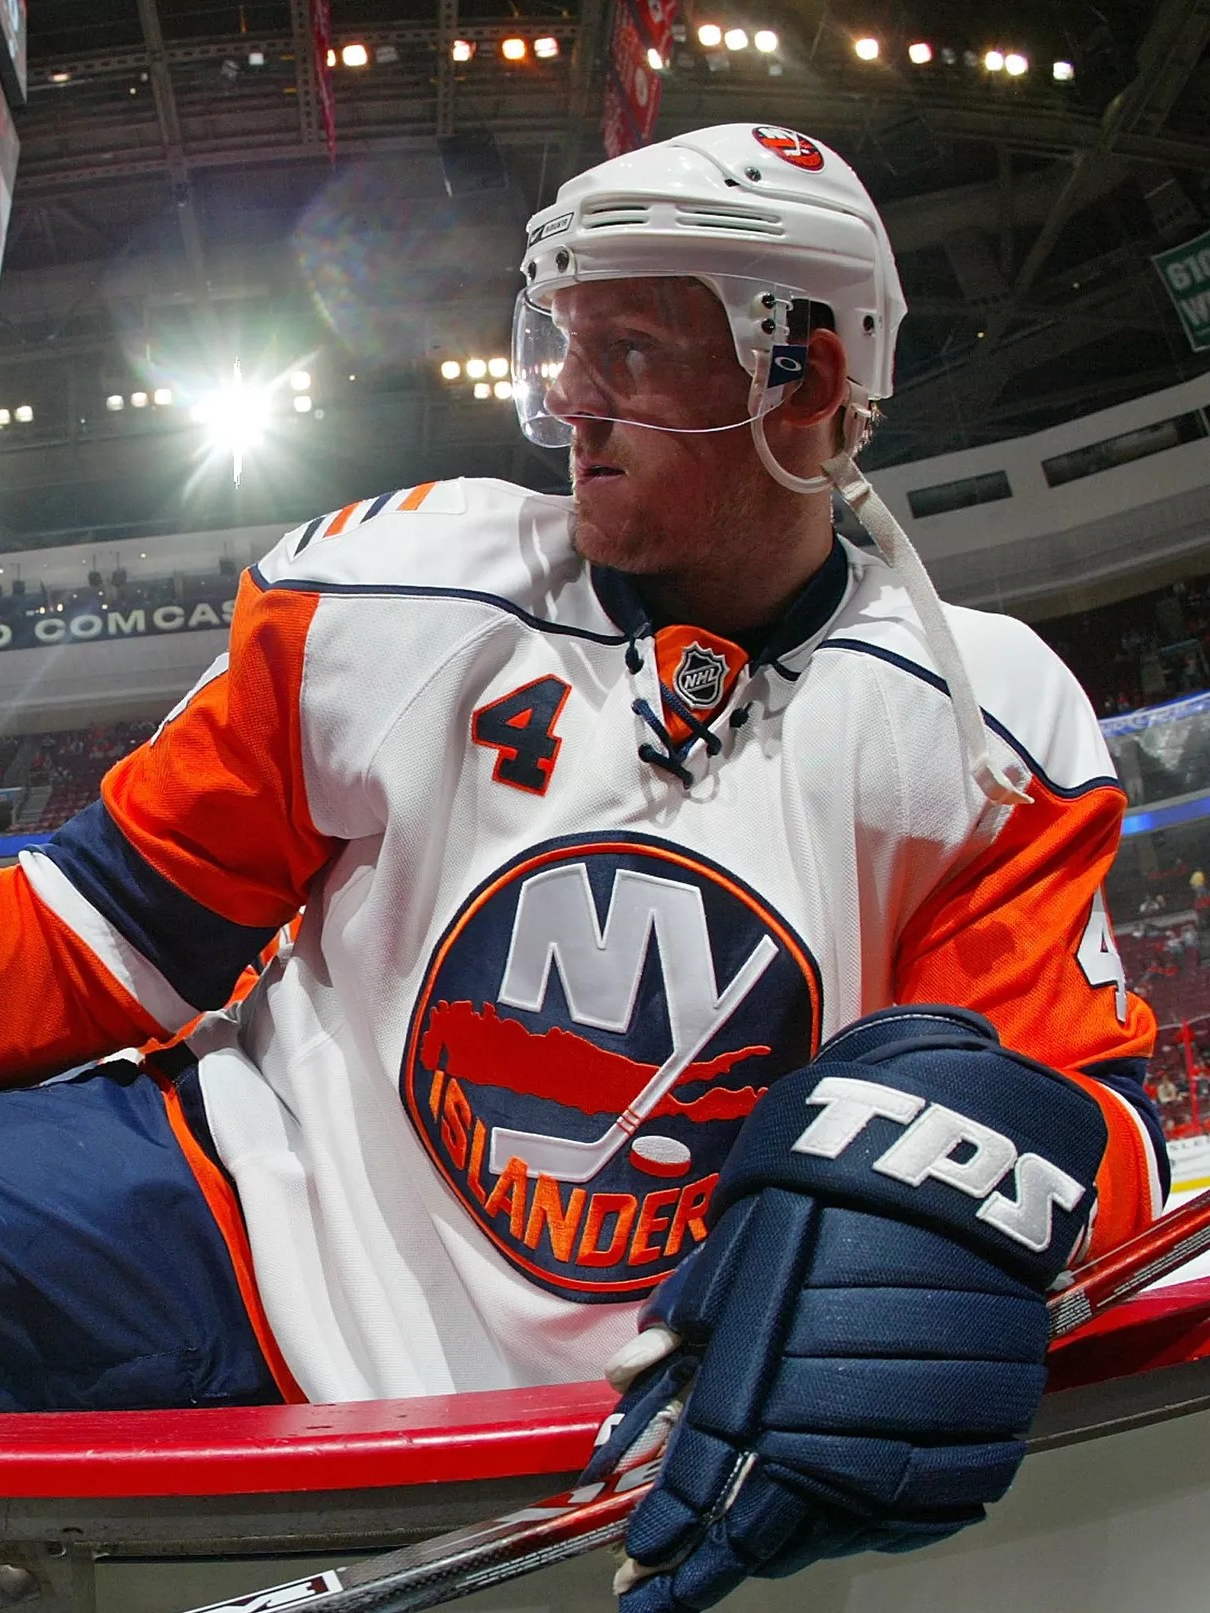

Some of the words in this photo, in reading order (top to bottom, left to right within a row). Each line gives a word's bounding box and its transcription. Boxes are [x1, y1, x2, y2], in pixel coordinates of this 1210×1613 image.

[472, 673, 572, 797] 4
[684, 668, 718, 690] NHL
[1077, 884, 1128, 1023] 4
[791, 1077, 1087, 1253] TPS
